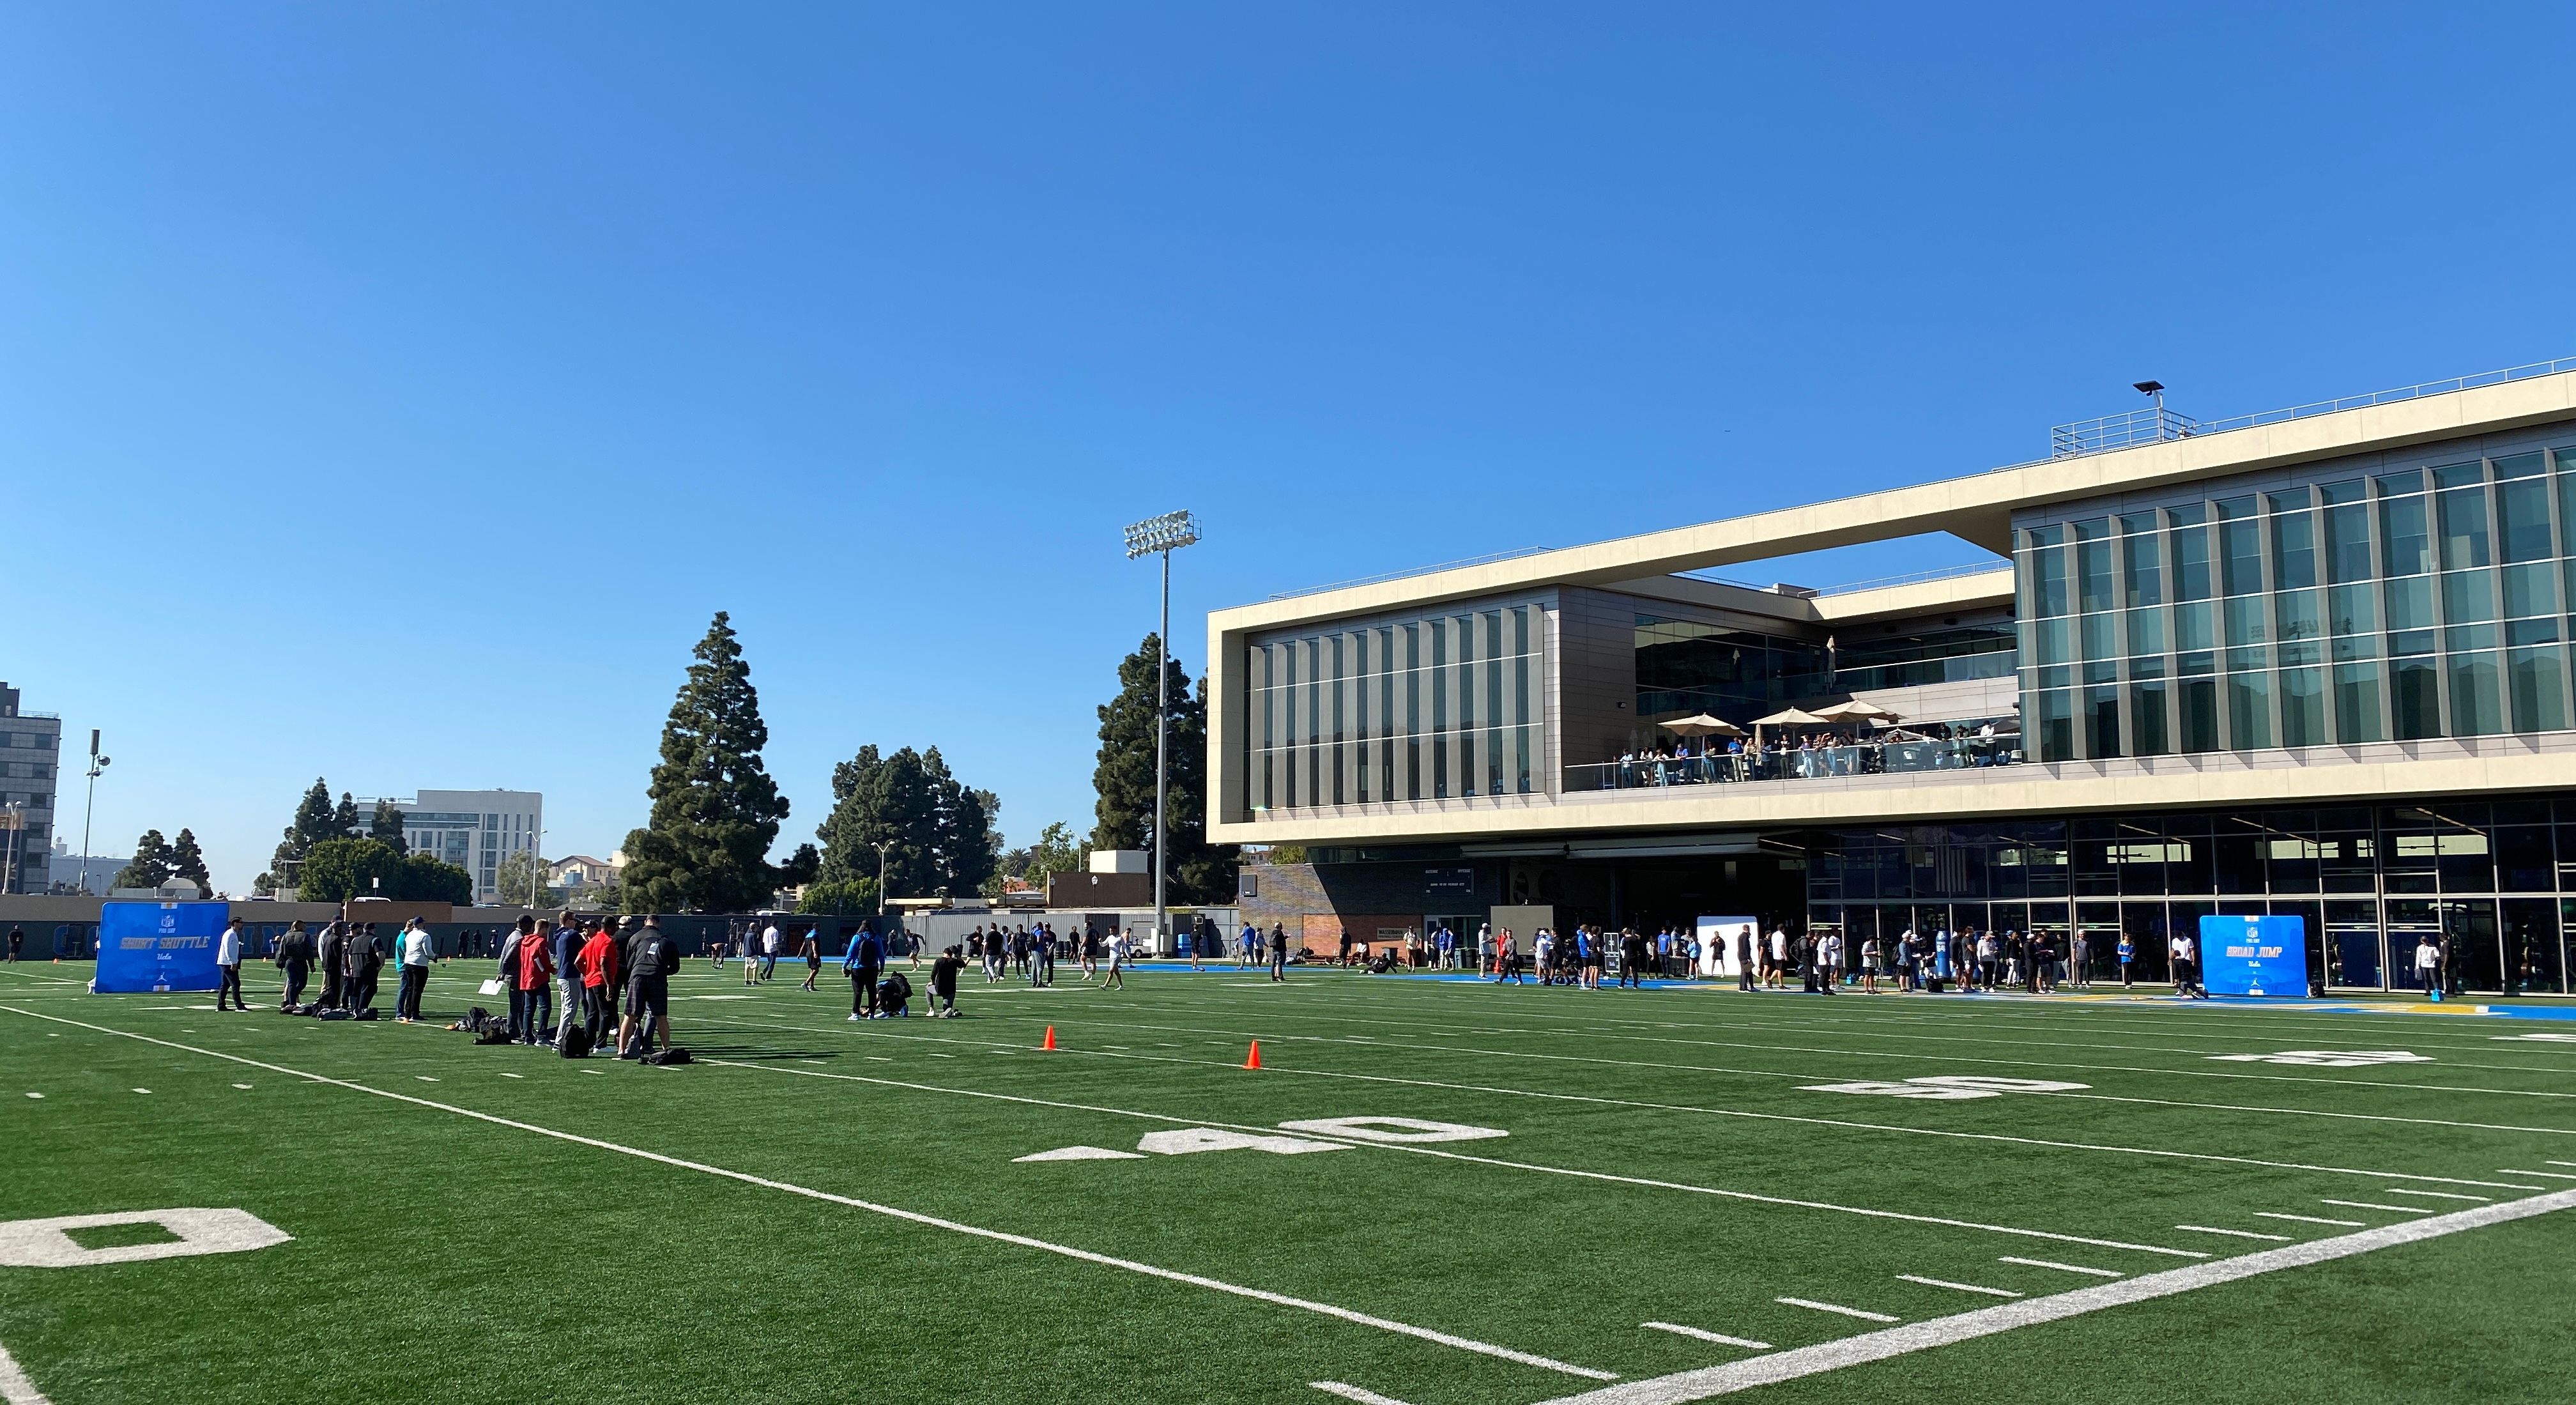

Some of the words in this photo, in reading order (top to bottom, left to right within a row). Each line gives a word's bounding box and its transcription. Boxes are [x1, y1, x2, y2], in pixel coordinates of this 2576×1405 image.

[120, 937, 157, 949] SHORT
[158, 936, 210, 949] SHUTTLE
[2226, 946, 2255, 957] BROAD
[2257, 946, 2283, 958] JUMP
[1137, 1116, 1510, 1155] 40
